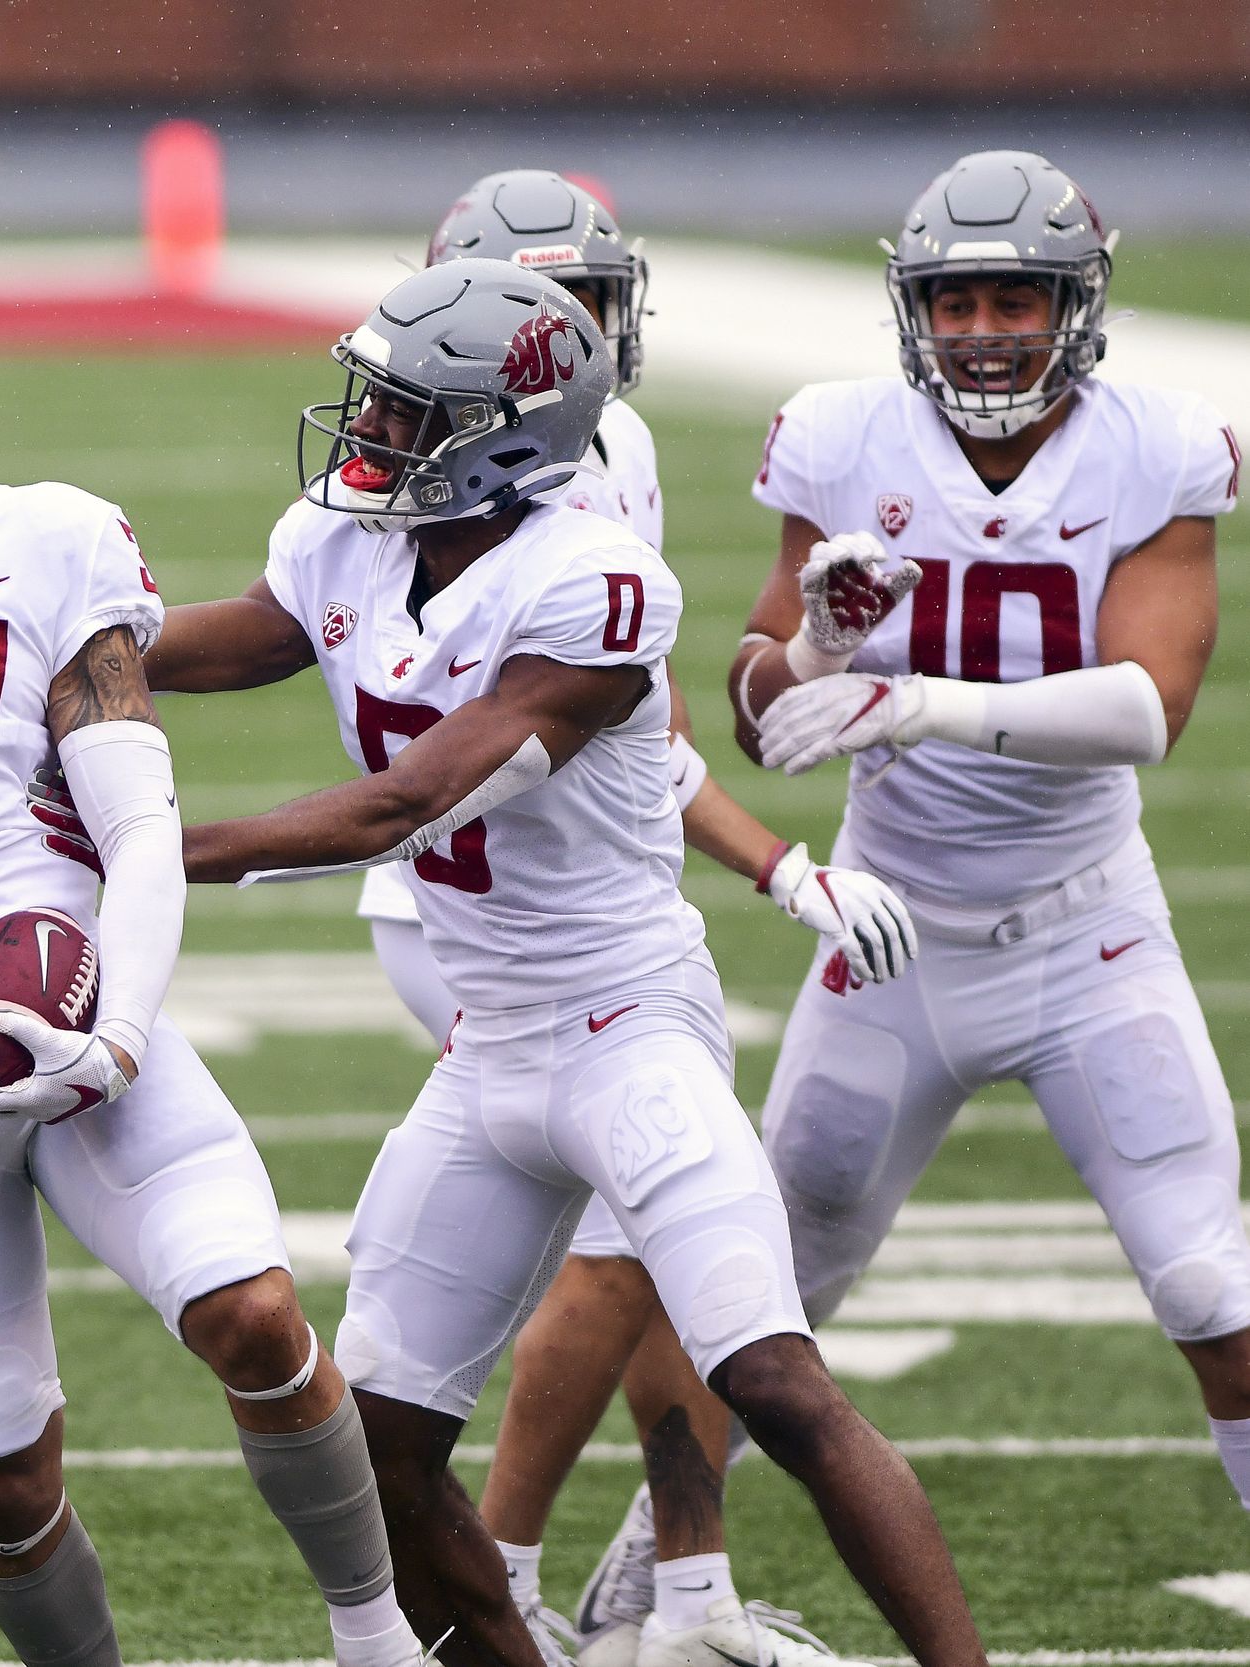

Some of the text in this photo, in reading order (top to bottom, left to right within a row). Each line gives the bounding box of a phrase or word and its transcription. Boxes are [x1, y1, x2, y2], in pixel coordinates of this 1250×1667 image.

[518, 249, 575, 265] Riddell
[322, 603, 357, 636] PAC
[324, 621, 343, 641] 12
